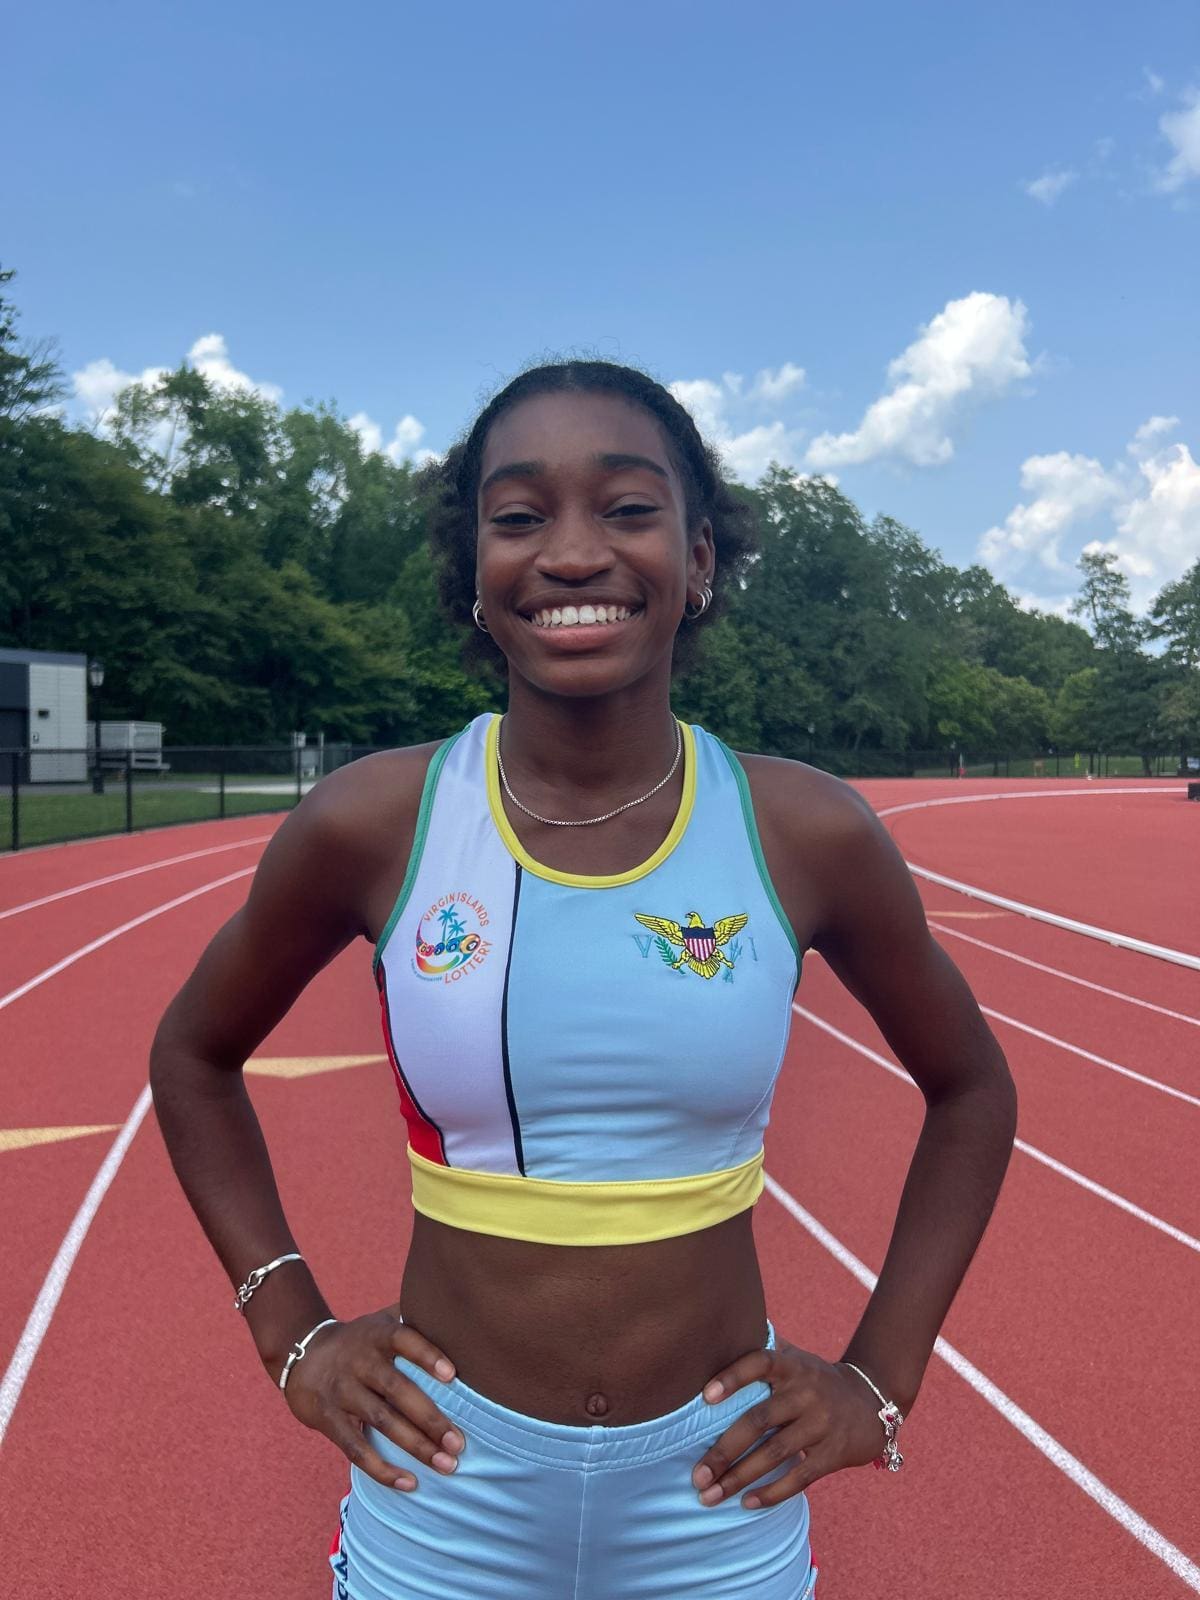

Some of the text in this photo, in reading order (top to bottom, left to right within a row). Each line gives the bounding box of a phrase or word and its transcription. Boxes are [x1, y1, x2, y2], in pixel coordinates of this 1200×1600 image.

[424, 891, 490, 927] VIRGIN ISLANDS
[444, 940, 493, 984] LOTTERY
[632, 934, 655, 958] V
